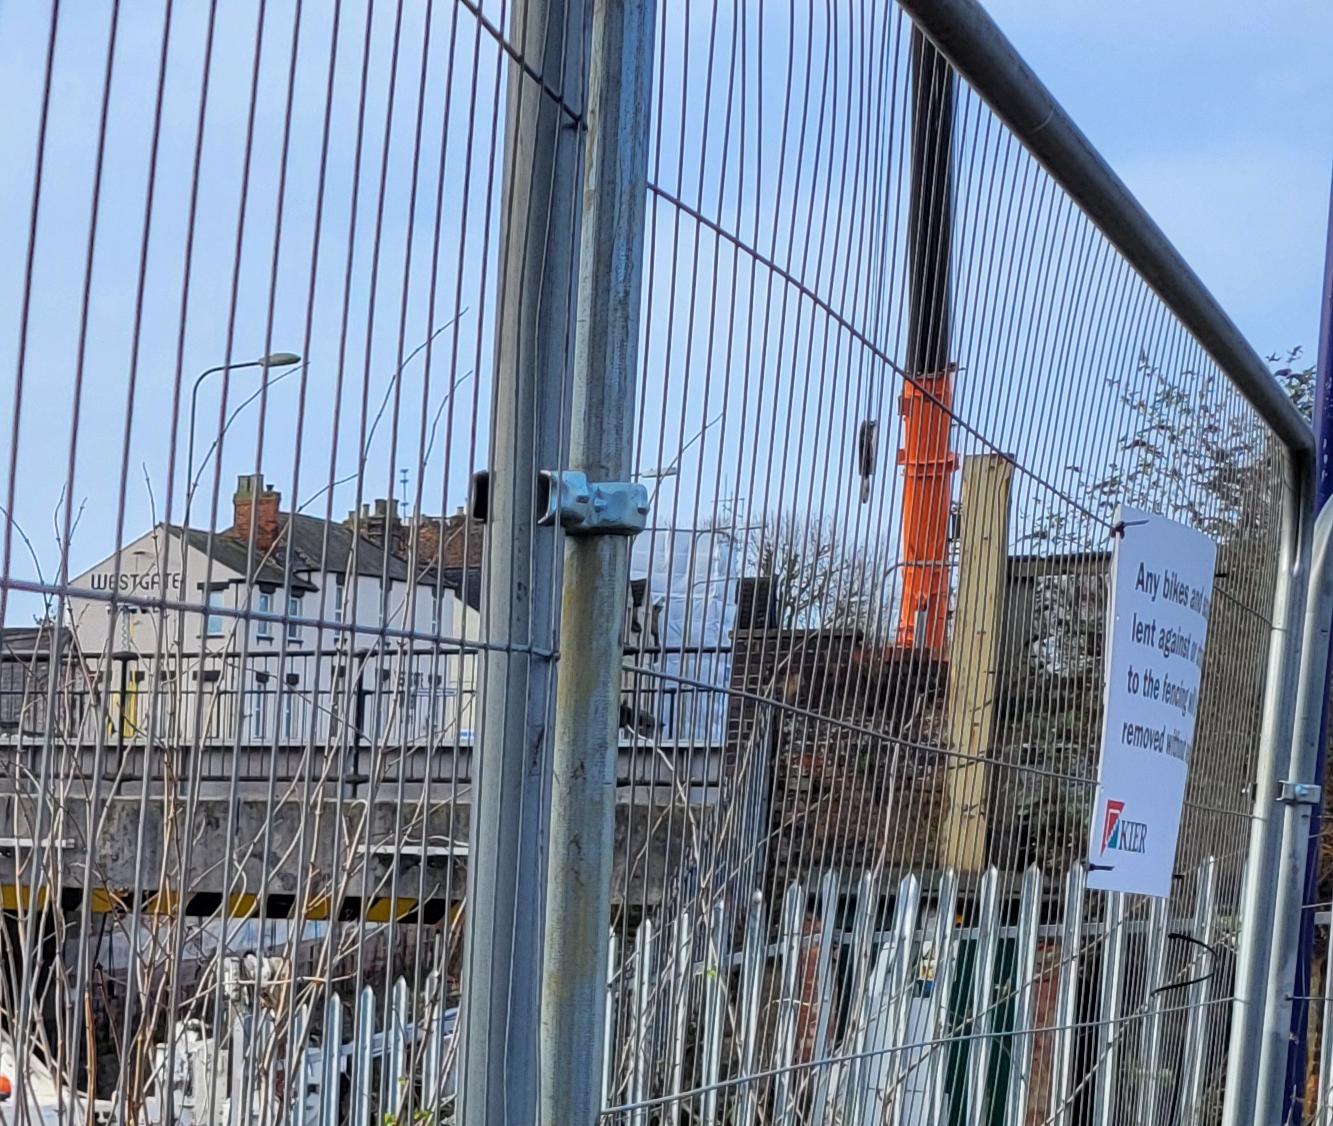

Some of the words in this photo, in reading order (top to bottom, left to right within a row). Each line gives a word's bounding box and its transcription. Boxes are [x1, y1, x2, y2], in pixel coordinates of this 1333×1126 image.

[91, 573, 181, 590] WESTGATE
[1135, 561, 1160, 602] Any
[1163, 569, 1189, 607] bikes
[1132, 612, 1156, 648] lent
[1157, 625, 1191, 660] against
[1128, 664, 1139, 695] to
[1143, 668, 1160, 700] the
[1162, 672, 1190, 717] fencing
[1121, 722, 1166, 753] removed
[1119, 820, 1147, 854] KIER
